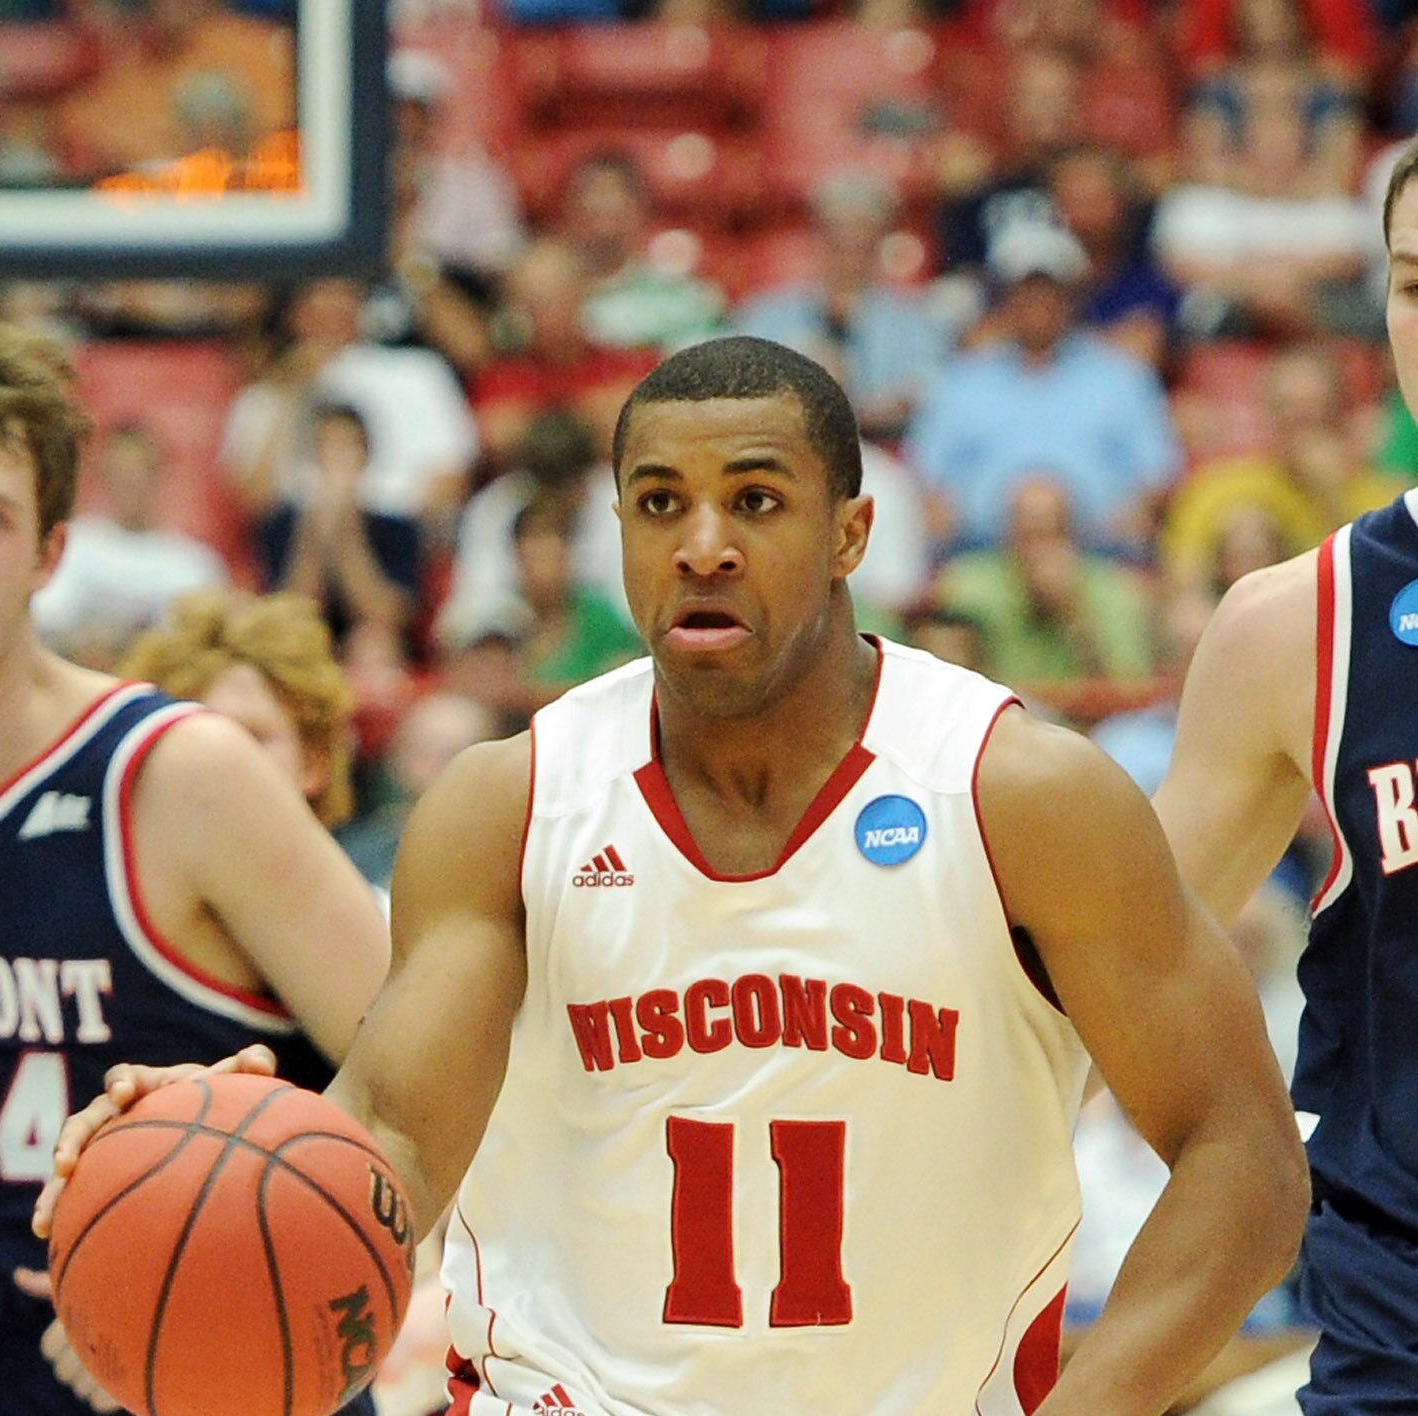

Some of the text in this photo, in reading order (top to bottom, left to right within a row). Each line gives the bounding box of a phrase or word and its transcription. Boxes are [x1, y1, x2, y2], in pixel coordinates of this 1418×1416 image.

[864, 826, 919, 848] NCAA
[572, 871, 634, 887] adidas
[567, 973, 959, 1081] WISCONSIN
[663, 1115, 853, 1328] 11
